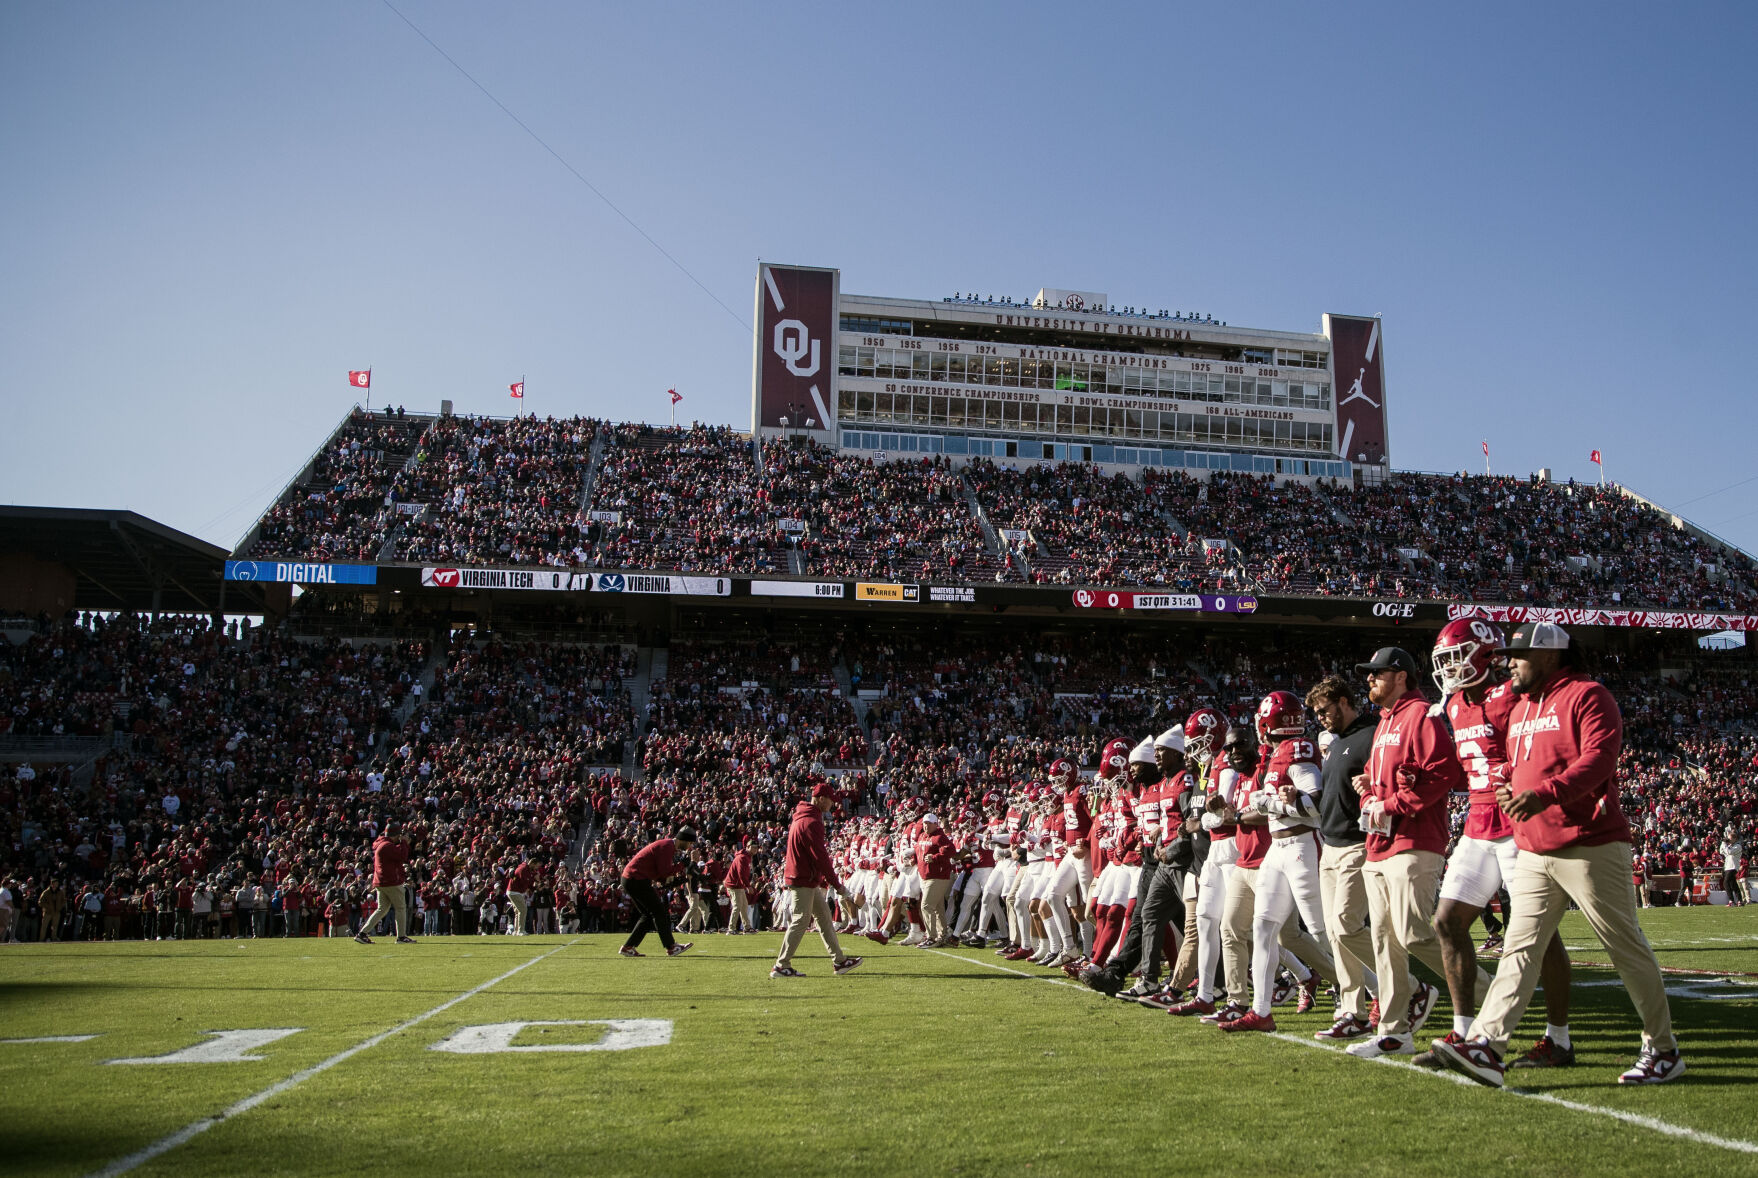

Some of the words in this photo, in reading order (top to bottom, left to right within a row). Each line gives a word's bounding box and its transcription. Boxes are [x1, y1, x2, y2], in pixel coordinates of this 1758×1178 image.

[996, 314, 1086, 332] UNIVERSITY
[1094, 322, 1109, 333] OF
[1118, 324, 1192, 340] OKLAHOMA
[774, 319, 820, 377] OU
[863, 337, 885, 347] 1950
[900, 340, 922, 349] 1955
[938, 342, 960, 351] 1956
[976, 345, 997, 355] 1974
[1020, 348, 1086, 363] NATIONAL
[1093, 354, 1168, 369] CHAMPIONS
[1191, 362, 1211, 372] 1975
[1225, 365, 1244, 375] 1985
[1258, 368, 1278, 377] 2000
[885, 383, 897, 393] 50
[900, 385, 962, 397] CONFERENCE
[965, 389, 1041, 402] CHAMPIONSHIPS
[1064, 396, 1074, 404] 31
[1079, 397, 1105, 407] BOWL
[1107, 399, 1179, 412] CHAMPIONSHIPS
[1223, 407, 1294, 421] ALL-AMERICANS
[600, 512, 612, 521] 103
[784, 520, 798, 530] 104
[276, 563, 337, 584] DIGITAL
[462, 570, 507, 588] VIRGINIA
[509, 572, 534, 588] TECH
[552, 573, 560, 589] 0
[573, 574, 590, 591] AT
[628, 576, 671, 593] VIRGINIA
[716, 579, 724, 594] 0
[815, 585, 830, 596] 6:00
[831, 585, 841, 596] PM
[904, 588, 917, 598] CAT
[930, 587, 955, 595] WHATEVER
[1077, 590, 1092, 608] OU
[1108, 594, 1119, 607] 0
[1139, 597, 1153, 607] 1ST
[1154, 597, 1169, 607] QTR
[1172, 597, 1195, 607] 31:41
[1215, 597, 1226, 611] 0
[1238, 602, 1257, 610] LSU
[1470, 621, 1494, 644] OU
[1293, 741, 1314, 759] 13
[1459, 741, 1489, 790] 3
